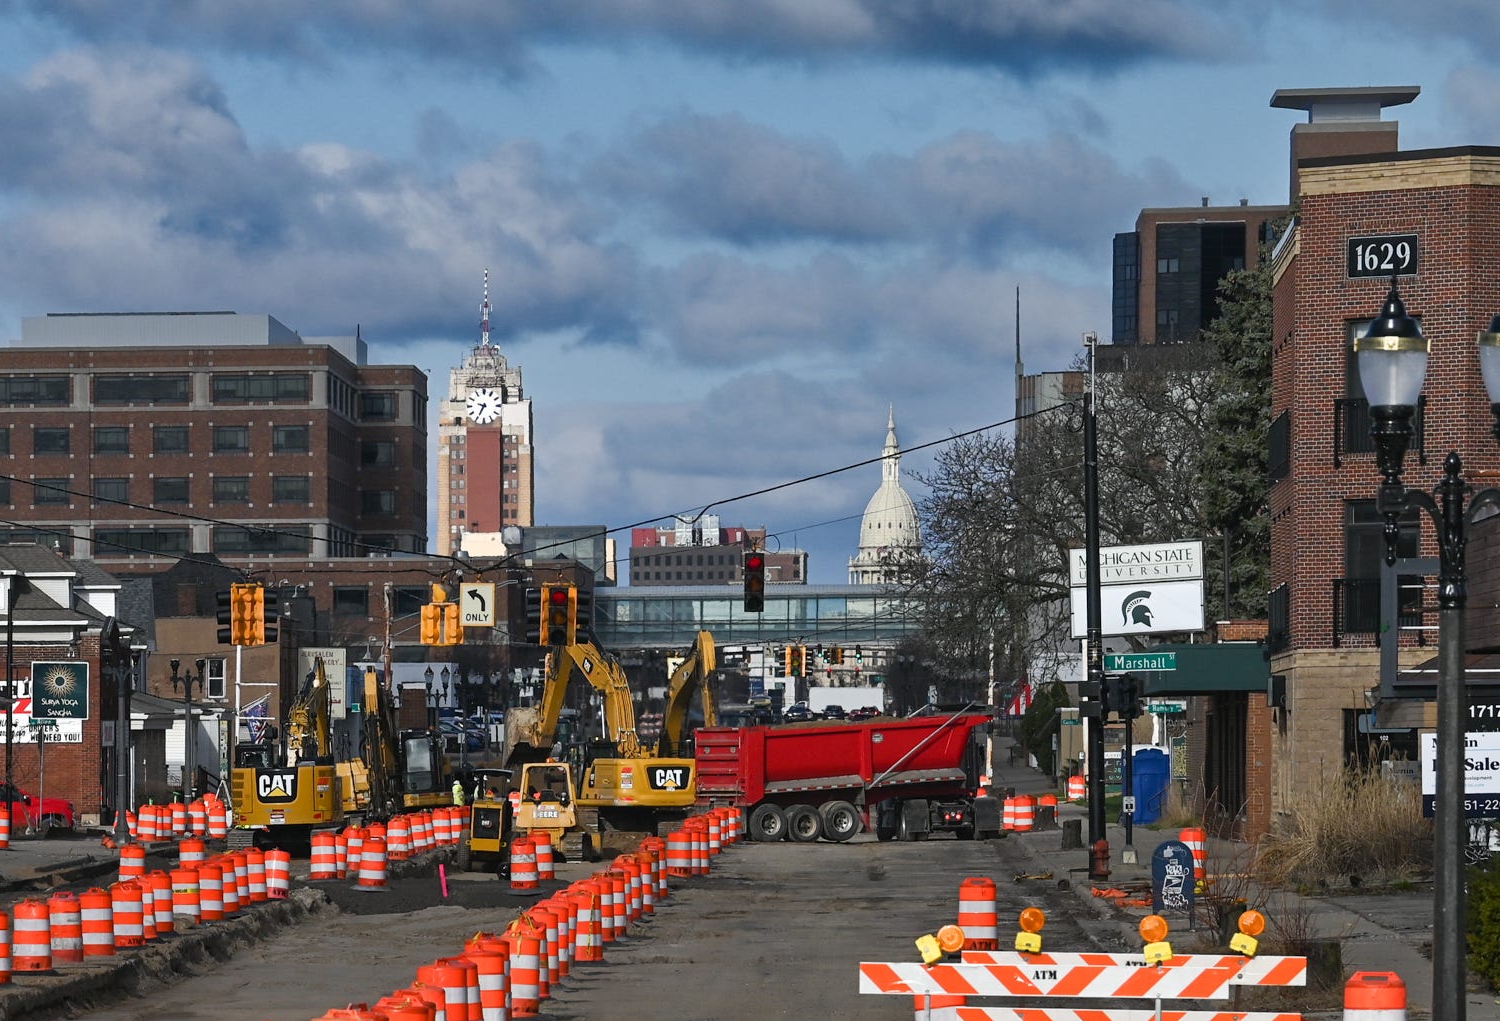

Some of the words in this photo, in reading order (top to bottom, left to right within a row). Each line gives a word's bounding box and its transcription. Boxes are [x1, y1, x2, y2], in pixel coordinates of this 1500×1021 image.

[1355, 242, 1411, 271] 1629
[1155, 548, 1193, 561] STATE
[1080, 564, 1193, 579] UIVERSITY
[465, 613, 489, 622] ONLY
[1114, 656, 1165, 669] Marshall
[61, 698, 78, 706] YOGA
[47, 708, 72, 717] SANGHA
[64, 733, 80, 741] YOU!
[1464, 757, 1499, 771] Sale
[655, 769, 682, 787] CAT
[259, 774, 294, 797] CAT
[1032, 970, 1057, 980] ATM
